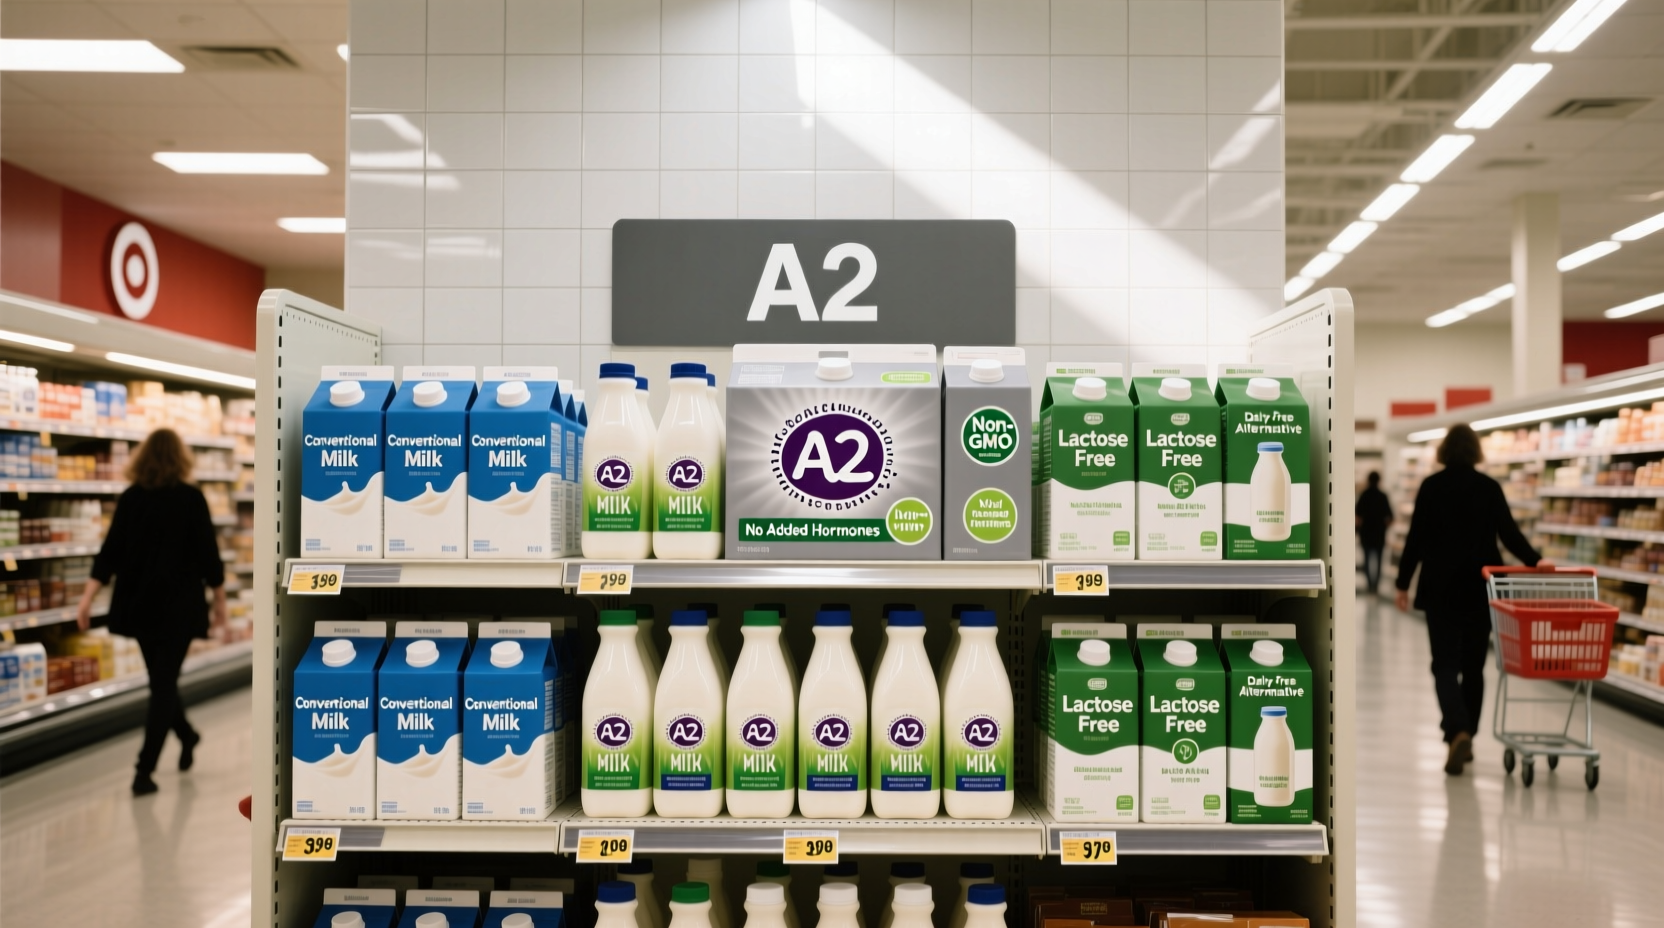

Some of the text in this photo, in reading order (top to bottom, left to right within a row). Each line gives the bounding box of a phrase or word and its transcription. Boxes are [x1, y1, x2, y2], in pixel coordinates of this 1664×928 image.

[746, 242, 878, 322] A2
[969, 413, 1016, 433] Non-
[968, 432, 1013, 450] GMO
[1058, 429, 1129, 448] Lactose
[1146, 429, 1217, 448] Lactose
[321, 449, 359, 467] Milk
[404, 449, 443, 468] Milk
[488, 449, 528, 468] Milk
[791, 429, 875, 483] A2
[1075, 449, 1116, 467] Free
[1161, 449, 1203, 467] Free
[600, 463, 630, 485] A2
[670, 463, 700, 483] A2
[745, 522, 881, 537] No Added Hormones
[1062, 694, 1134, 713] Lactose
[1150, 695, 1220, 714] Lactose
[311, 711, 350, 730] Milk
[397, 712, 435, 731] Milk
[482, 712, 521, 731] Milk
[1078, 715, 1120, 733] Free
[1165, 715, 1207, 733] Free
[599, 720, 627, 741] A2
[671, 720, 700, 741] A2
[745, 720, 774, 744] A2
[817, 721, 847, 744] A2
[892, 721, 920, 742] A2
[966, 721, 995, 742] A2
